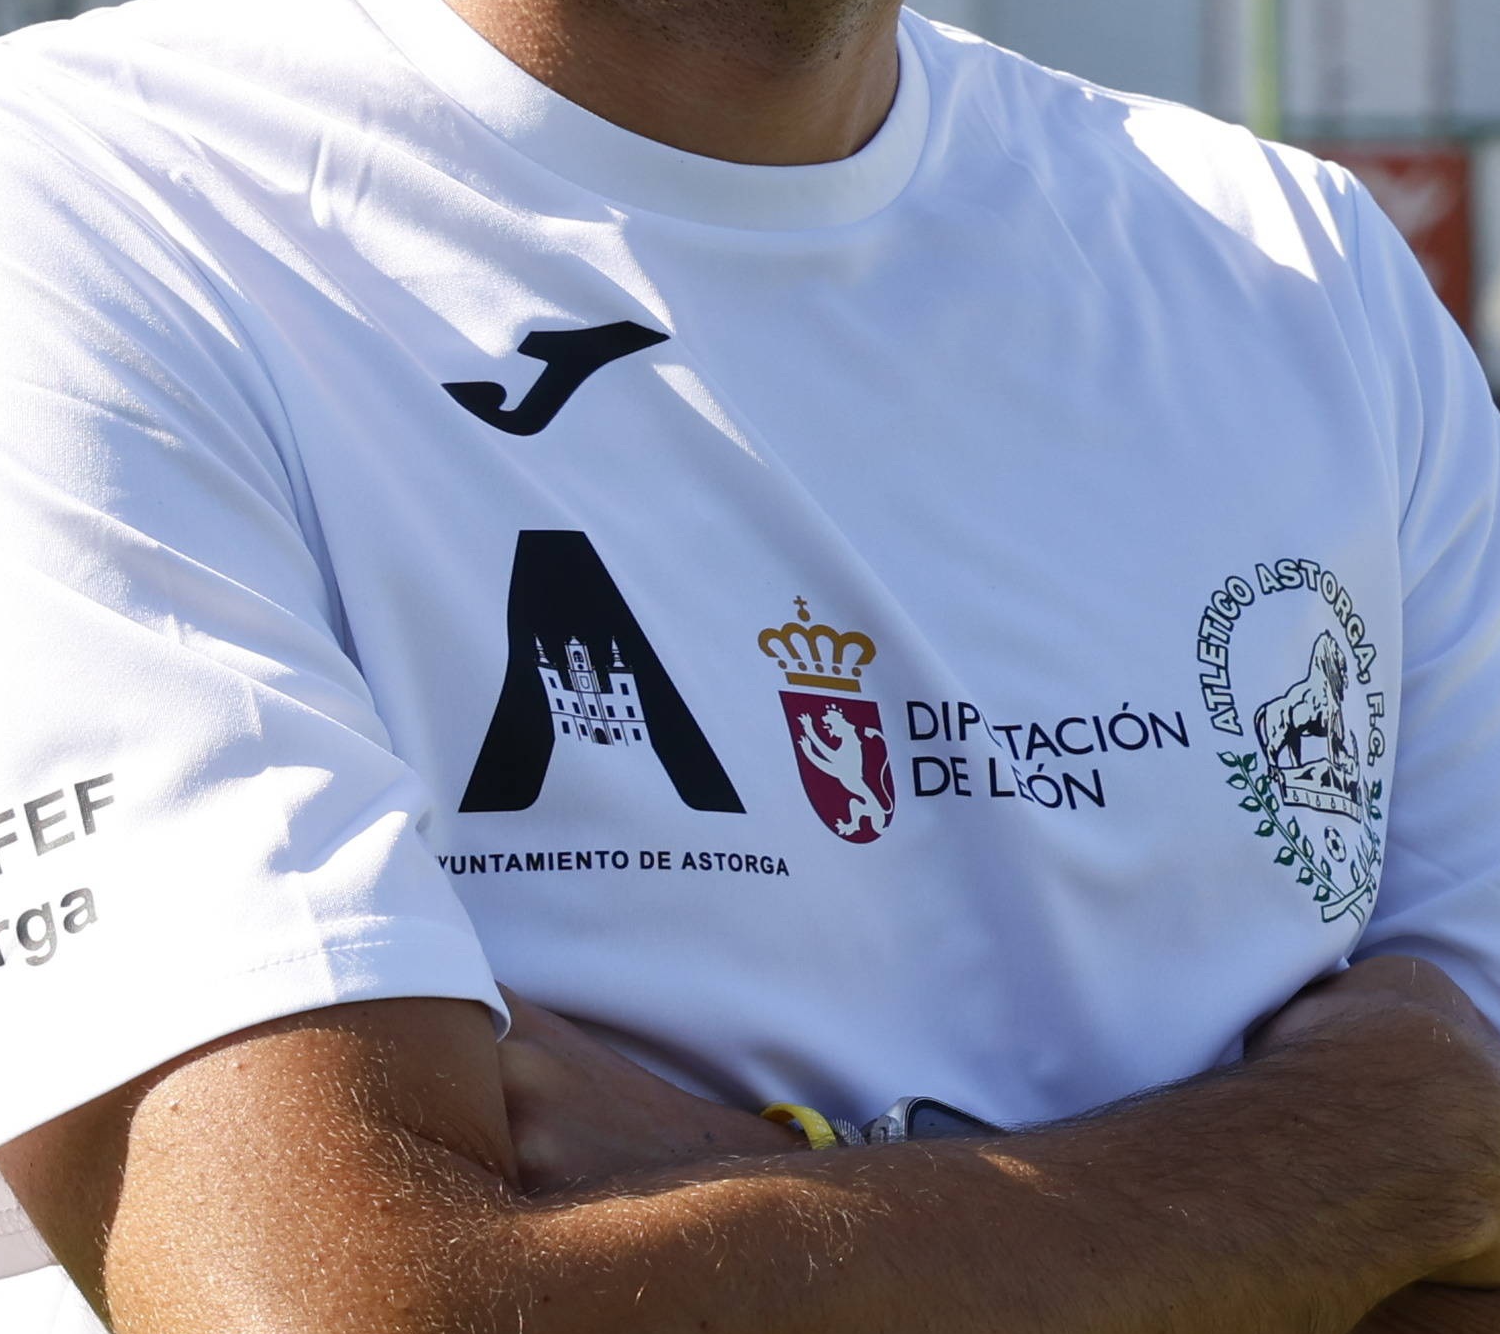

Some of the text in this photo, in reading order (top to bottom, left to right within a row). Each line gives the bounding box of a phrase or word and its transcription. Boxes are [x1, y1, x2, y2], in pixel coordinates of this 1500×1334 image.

[1196, 574, 1255, 736] ATLETICO
[911, 756, 972, 798] DE
[435, 850, 790, 876] YUNTAMIENTO DE ASTORGA
